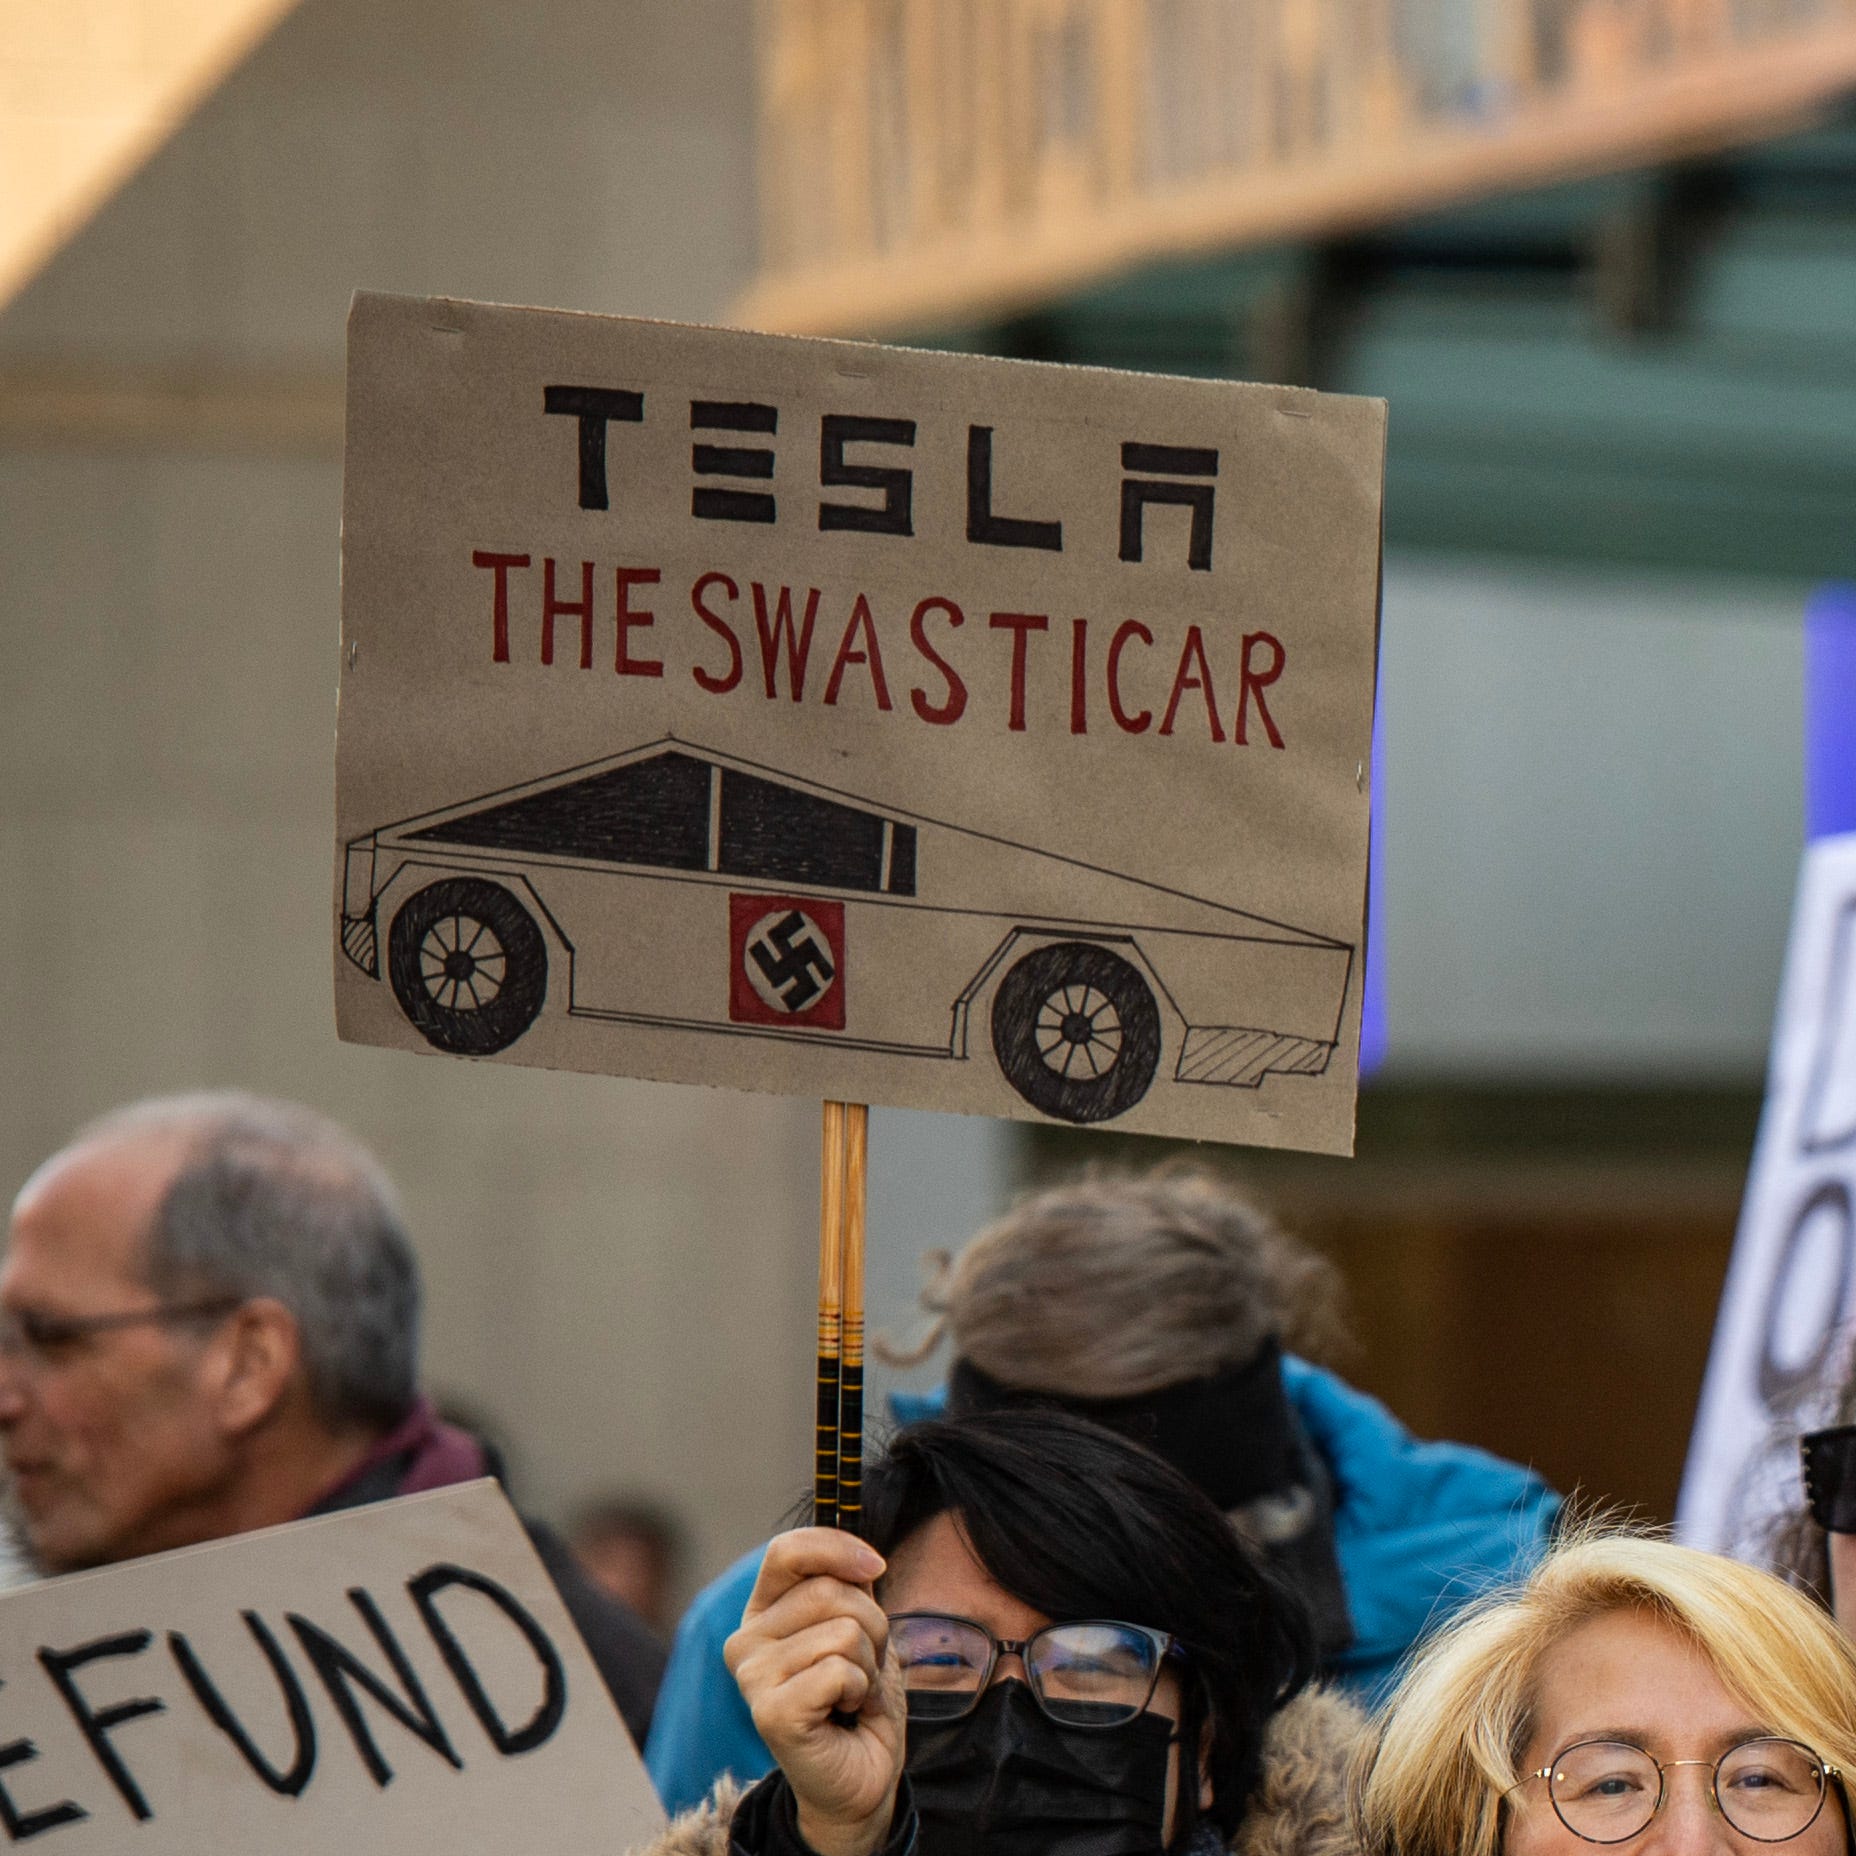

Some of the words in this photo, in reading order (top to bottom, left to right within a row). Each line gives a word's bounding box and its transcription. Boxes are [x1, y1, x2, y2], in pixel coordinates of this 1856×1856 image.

[542, 385, 1219, 571] TESLA
[472, 551, 666, 678] THE
[689, 570, 1288, 750] SWASTICAR
